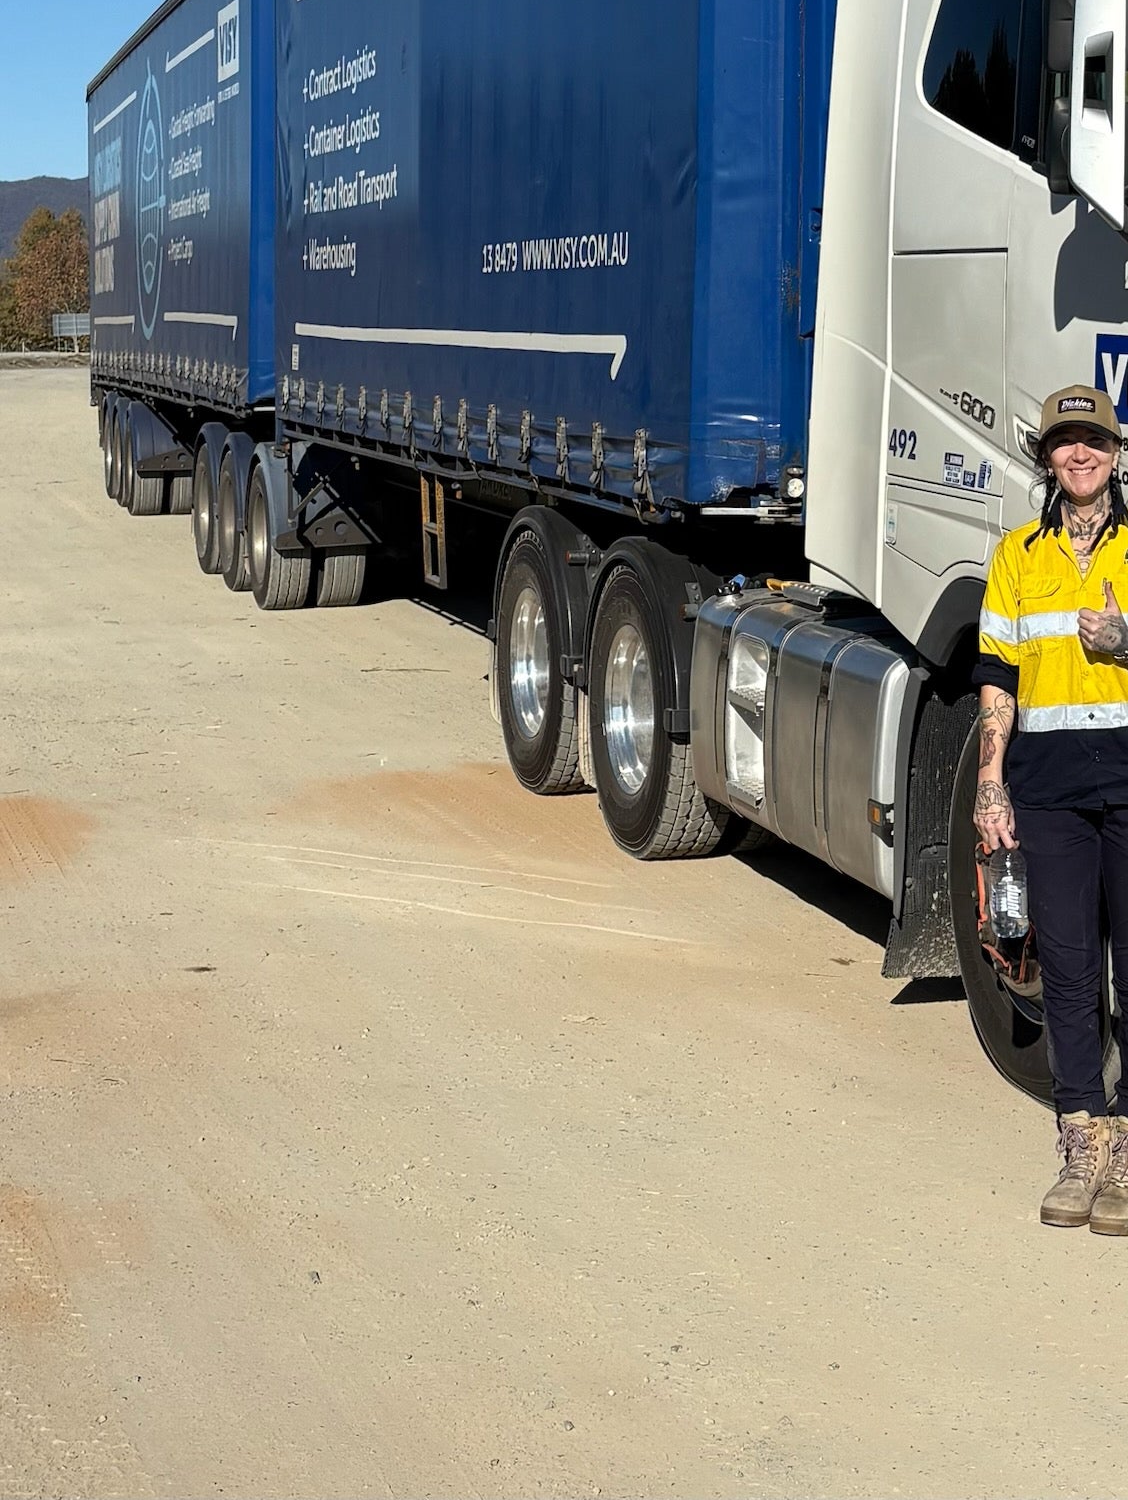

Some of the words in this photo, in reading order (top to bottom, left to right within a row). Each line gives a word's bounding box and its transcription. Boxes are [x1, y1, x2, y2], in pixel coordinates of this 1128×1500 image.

[219, 14, 238, 68] VISY
[308, 59, 341, 101] Contract
[342, 44, 376, 94] Logistics
[309, 119, 345, 158] Container
[346, 105, 380, 154] Logistics
[309, 180, 323, 214] Rail
[323, 178, 338, 212] and
[338, 172, 358, 210] Road
[358, 163, 398, 211] Transport
[308, 235, 357, 277] Warehousing
[482, 244, 493, 274] 13
[494, 242, 518, 273] 8479
[522, 231, 629, 272] WWW.VISY.COM.AU
[960, 391, 996, 430] 600
[888, 428, 917, 461] 492
[1006, 884, 1022, 919] pump
